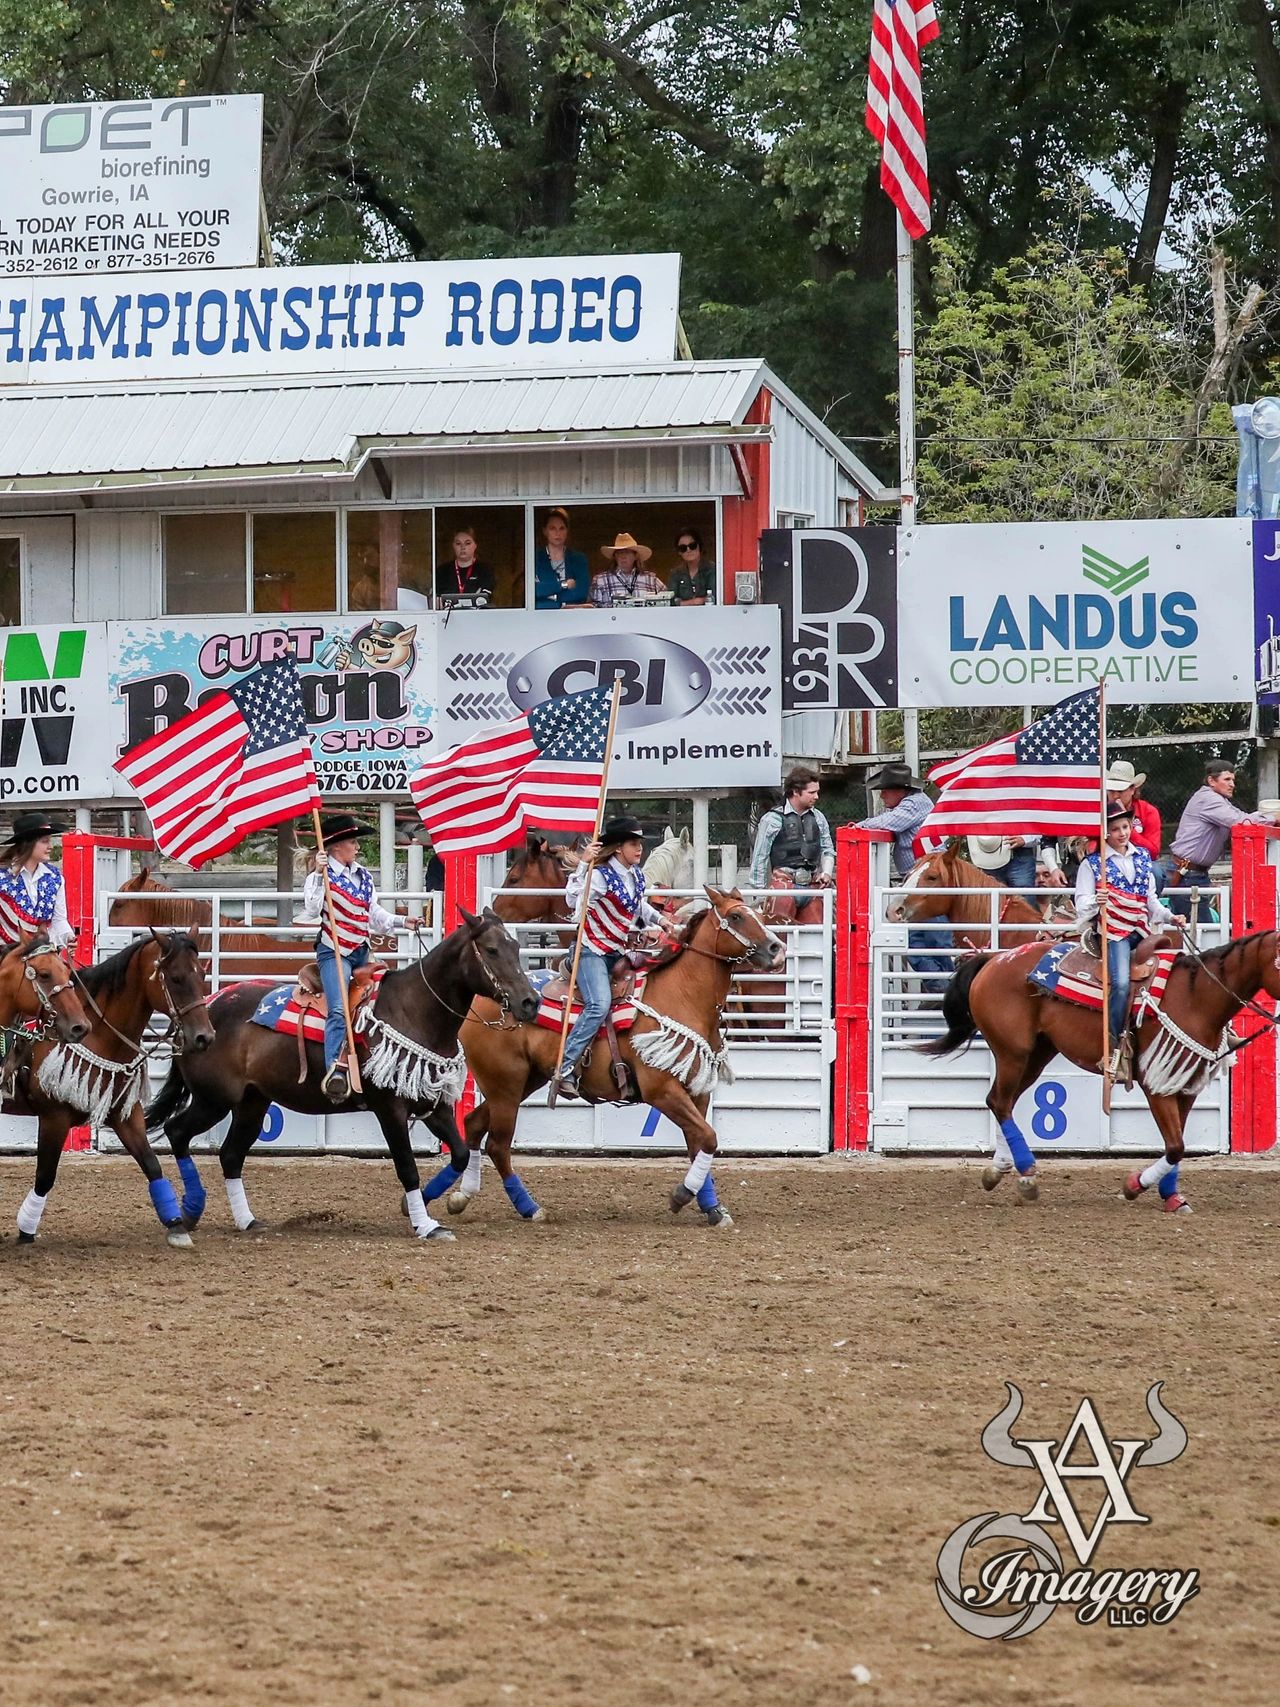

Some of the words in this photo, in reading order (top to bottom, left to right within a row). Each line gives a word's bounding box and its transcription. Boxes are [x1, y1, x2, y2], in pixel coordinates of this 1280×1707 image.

[101, 155, 211, 179] biorefining
[42, 187, 120, 206] Gowrie,
[129, 184, 150, 202] IA
[16, 216, 77, 234] TODAY
[85, 214, 125, 231] FOR
[133, 212, 169, 229] ALL
[177, 209, 231, 227] YOUR
[32, 233, 146, 255] MARKETING
[154, 230, 221, 249] NEEDS
[84, 258, 101, 270] or
[107, 250, 215, 269] 877-351-2676
[445, 275, 642, 348] RODEO
[949, 591, 1199, 652] LANDUS
[198, 627, 324, 679] CURT
[547, 658, 666, 706] CBI
[949, 655, 1199, 685] COOPERATIVE
[20, 685, 76, 714] INC.
[320, 726, 434, 754] SHOP
[627, 737, 772, 766] Implement
[314, 761, 365, 774] DODGE,
[369, 759, 408, 772] IOWA
[1031, 1081, 1067, 1141] 8
